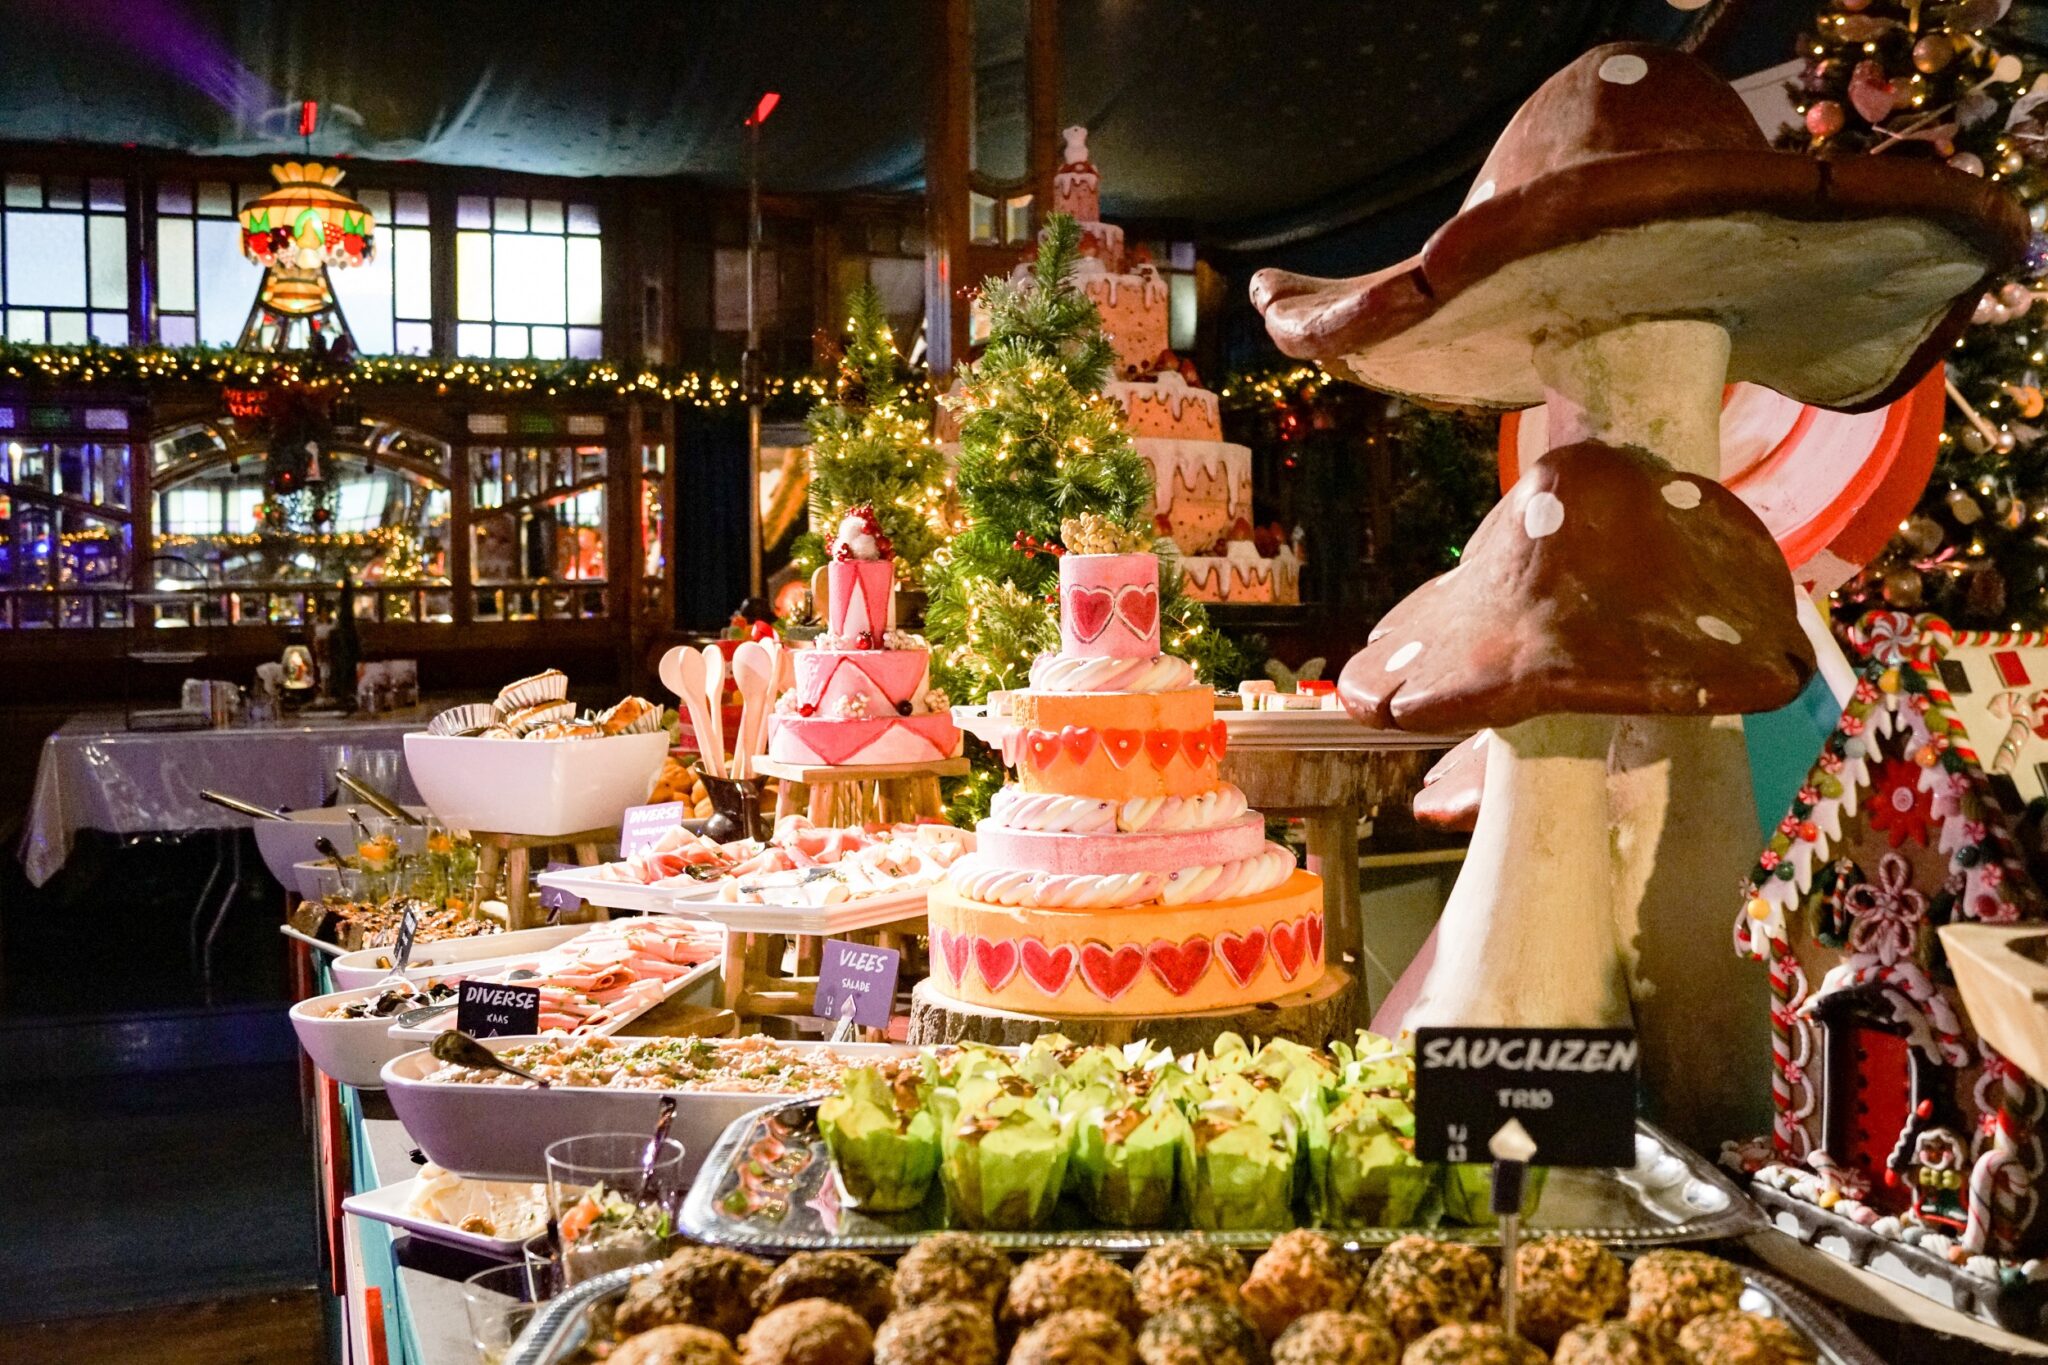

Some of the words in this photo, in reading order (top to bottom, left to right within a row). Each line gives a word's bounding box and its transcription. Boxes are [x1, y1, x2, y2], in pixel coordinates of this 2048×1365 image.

[629, 806, 681, 824] DIVERSE
[840, 949, 888, 973] VLEES
[842, 978, 871, 992] SALADE
[466, 987, 537, 1009] DIVERSE
[487, 1013, 509, 1025] KAAS
[1423, 1036, 1638, 1072] SAUCIJZEN
[1498, 1088, 1554, 1109] TRIO
